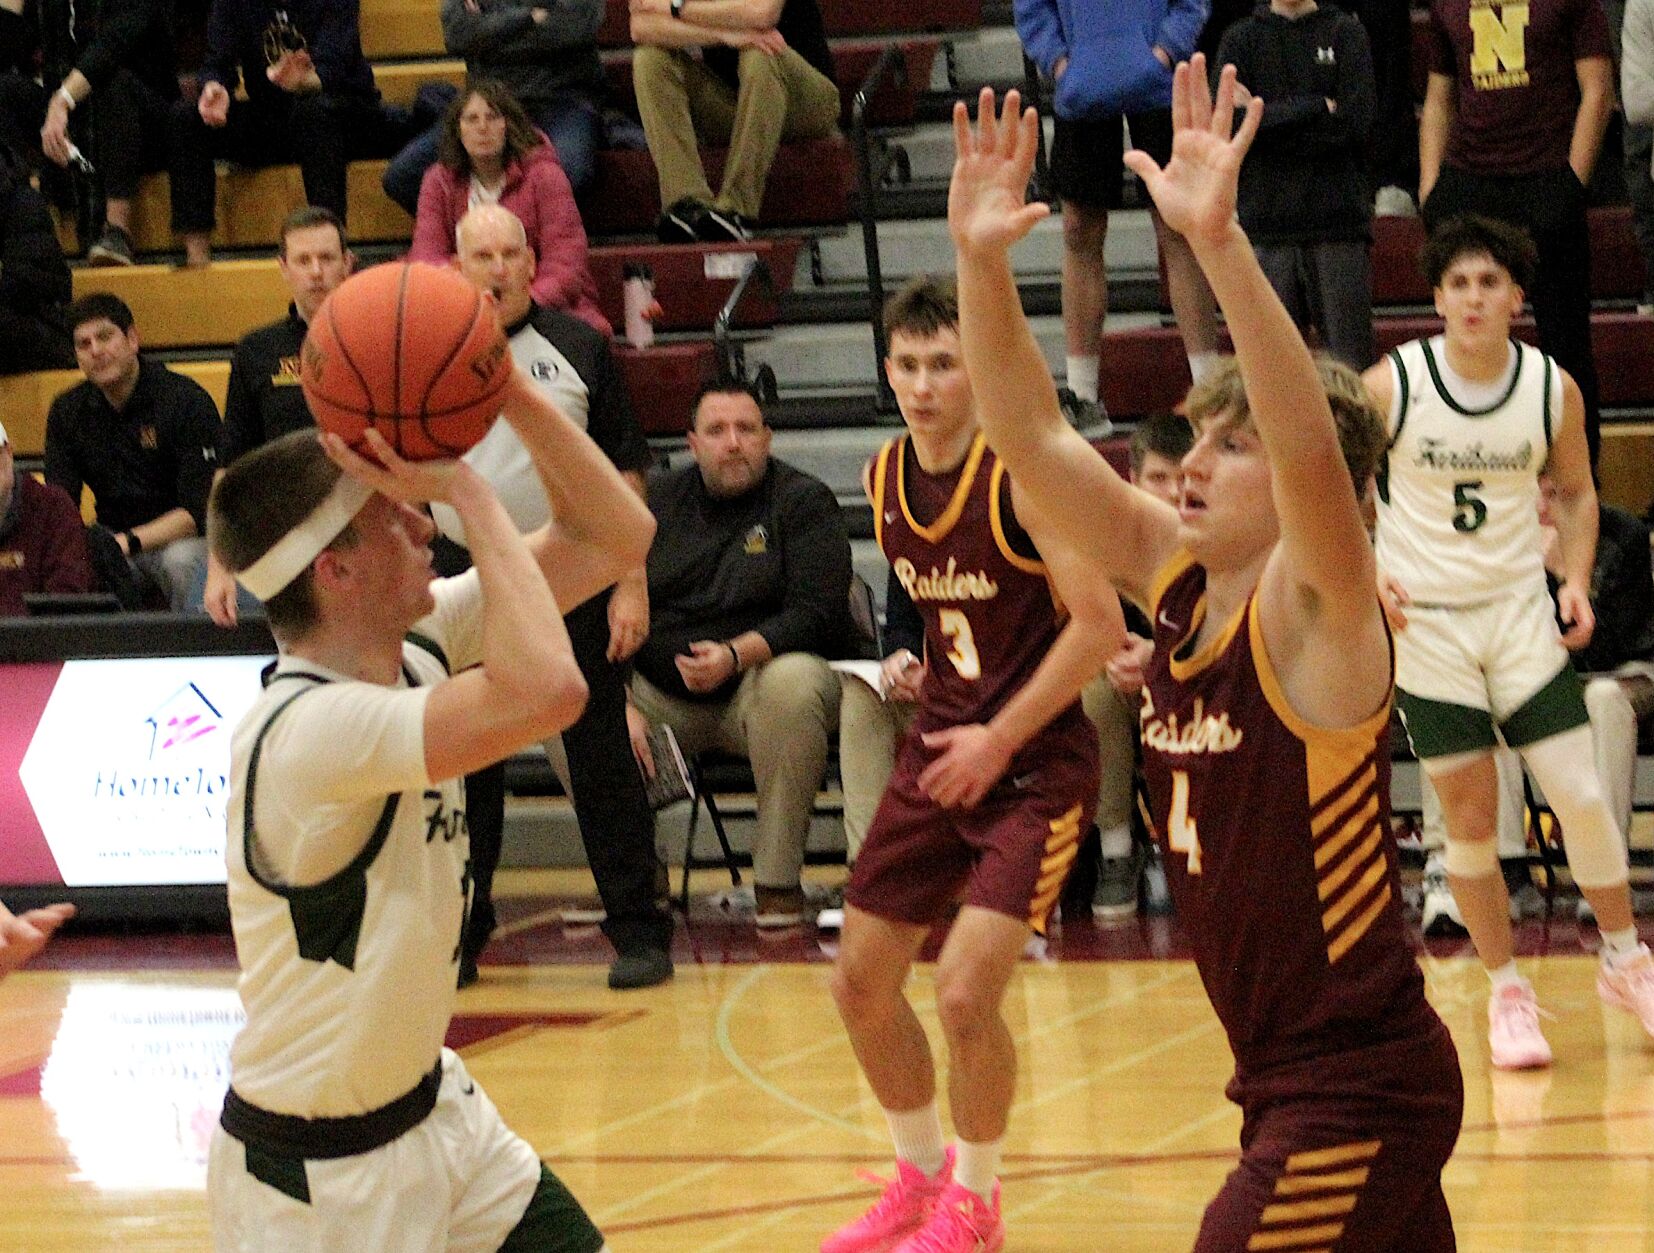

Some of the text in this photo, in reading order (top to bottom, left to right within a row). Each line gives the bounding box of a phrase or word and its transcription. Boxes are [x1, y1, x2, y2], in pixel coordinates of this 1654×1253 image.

[1469, 7, 1530, 73] N
[1453, 480, 1487, 533] 5
[894, 556, 998, 600] Raiders
[938, 607, 981, 680] 3
[1167, 770, 1202, 876] 4
